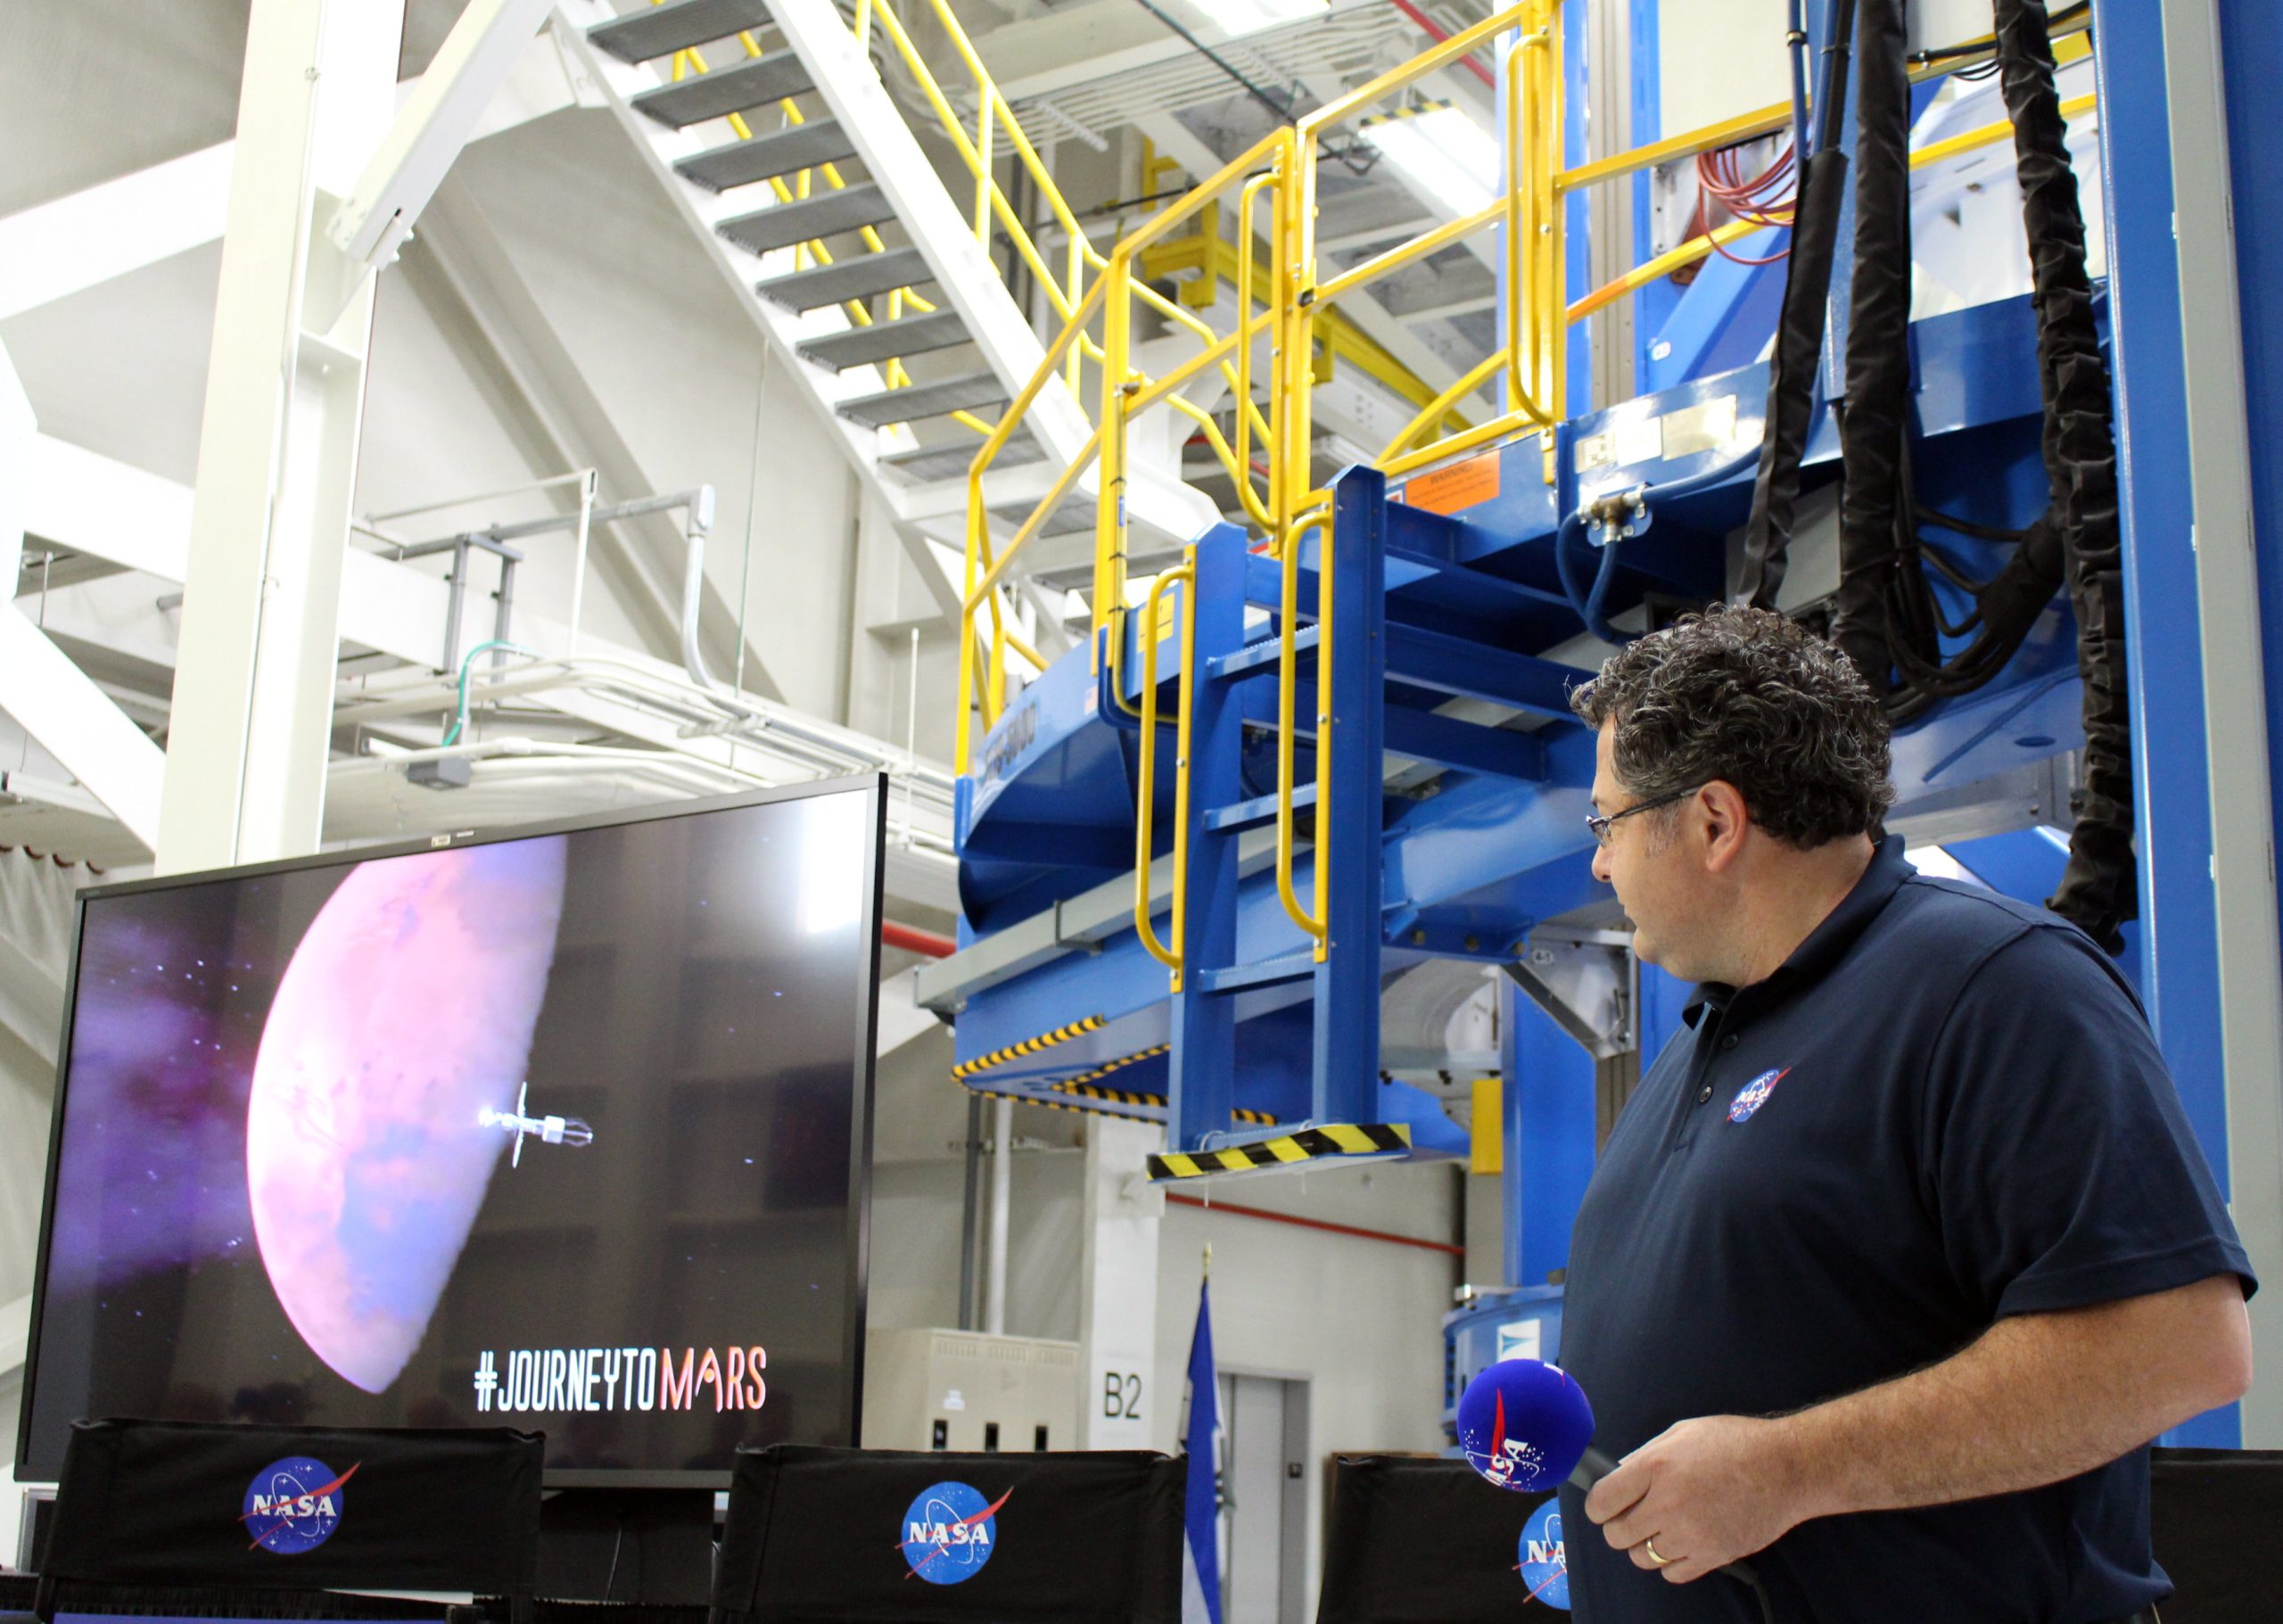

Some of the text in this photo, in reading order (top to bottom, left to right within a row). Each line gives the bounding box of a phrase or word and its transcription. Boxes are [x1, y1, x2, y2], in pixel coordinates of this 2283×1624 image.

[474, 1346, 767, 1414] #JOURNEYTOMARS
[1104, 1372, 1142, 1419] B2
[1484, 1438, 1529, 1488] ASA
[252, 1494, 337, 1518] NASA
[909, 1521, 990, 1545] NASA
[1527, 1539, 1567, 1563] NA
